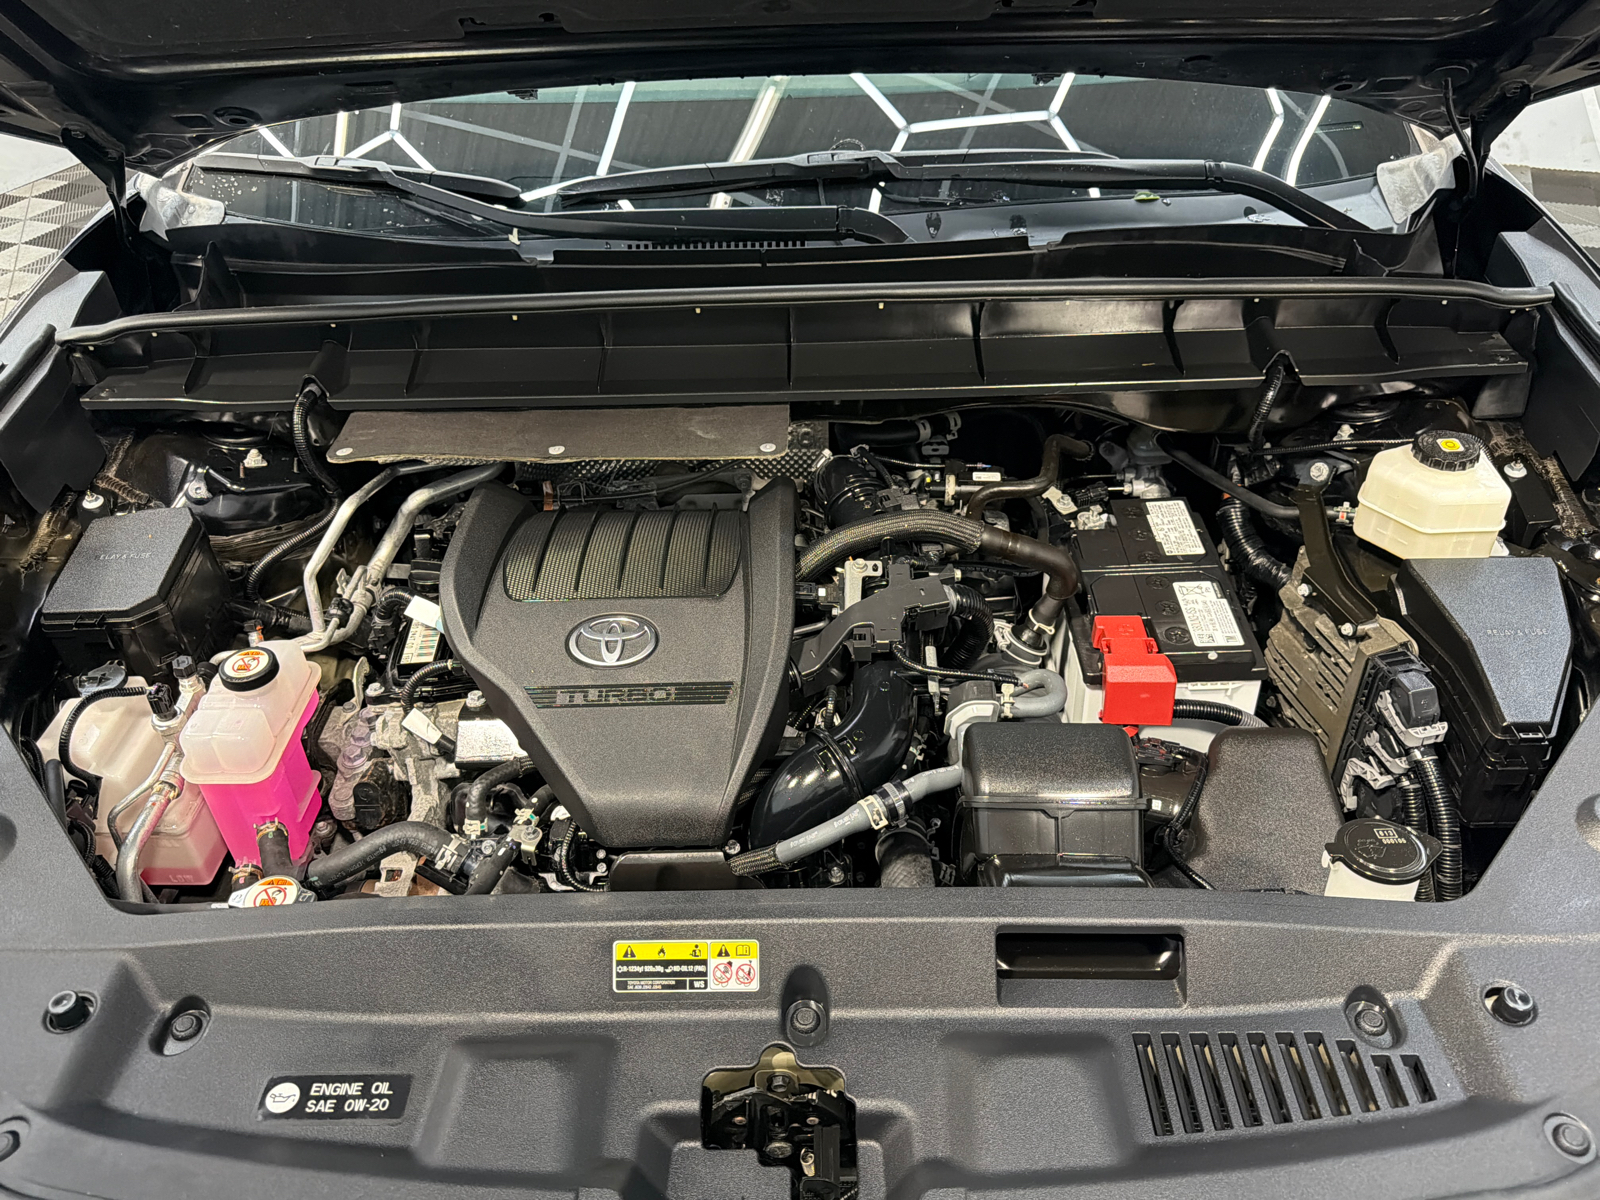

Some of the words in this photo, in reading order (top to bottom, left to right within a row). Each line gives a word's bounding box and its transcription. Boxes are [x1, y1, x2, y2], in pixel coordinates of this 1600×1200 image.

[556, 687, 676, 705] TURBO
[309, 1082, 365, 1096] ENGINE
[371, 1081, 394, 1095] OIL
[305, 1099, 337, 1113] SAE
[344, 1098, 390, 1112] 0W-20
